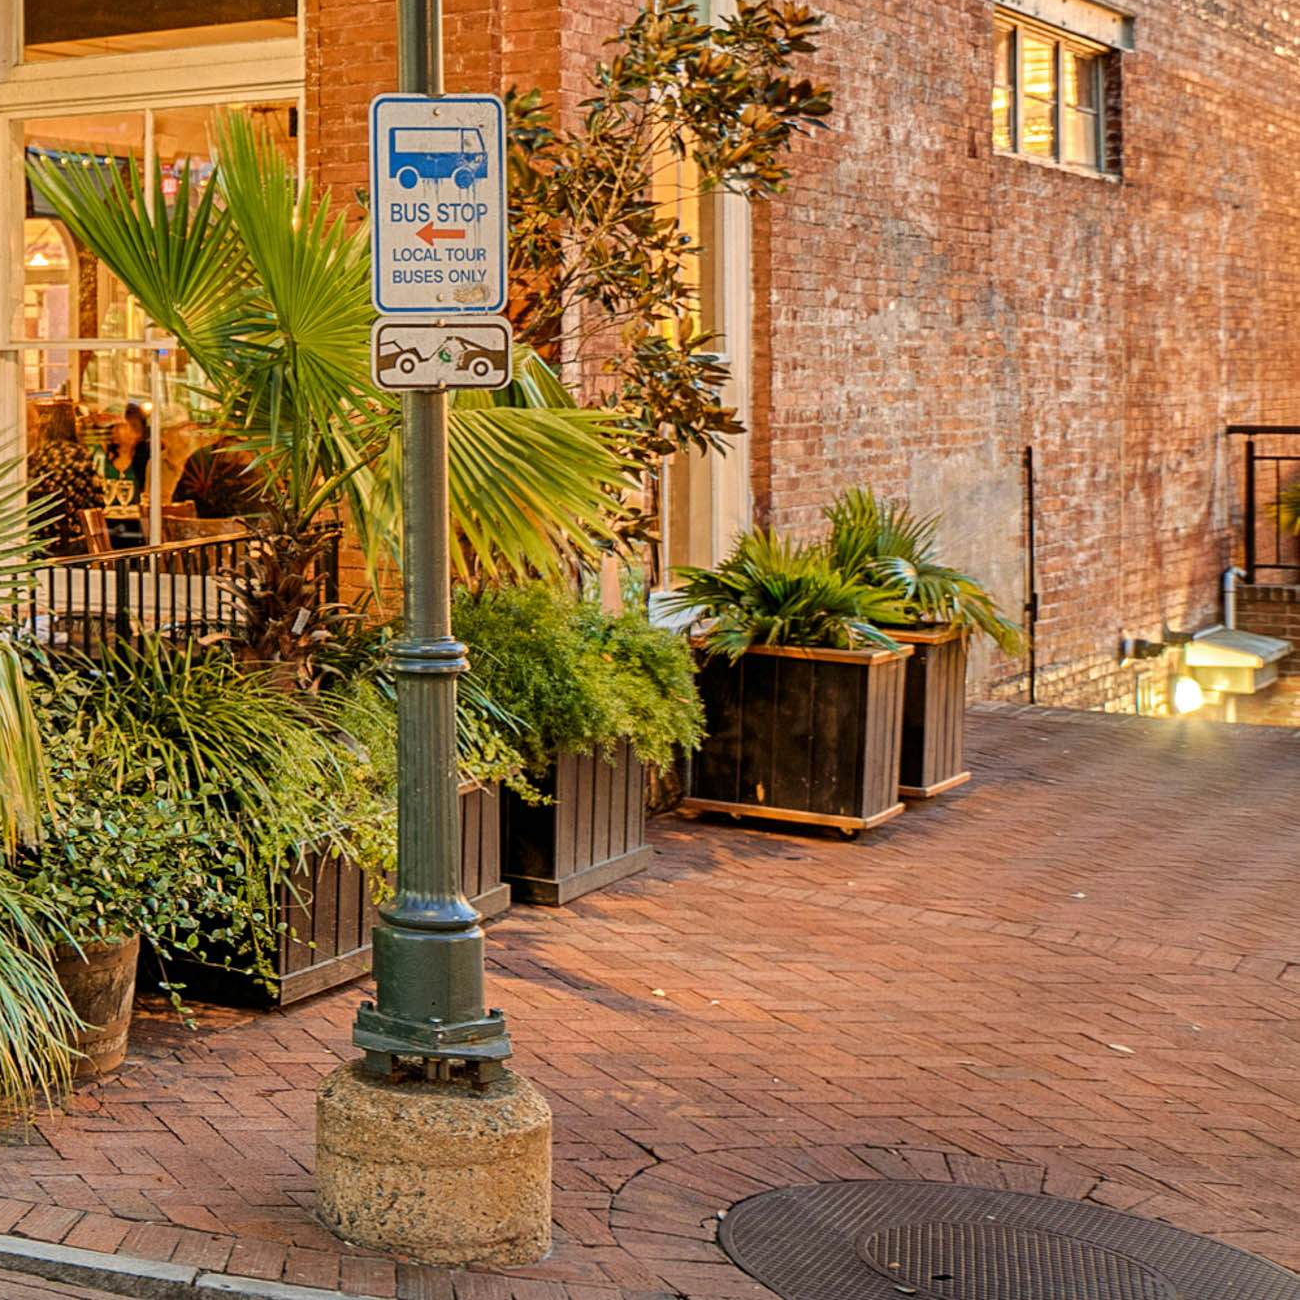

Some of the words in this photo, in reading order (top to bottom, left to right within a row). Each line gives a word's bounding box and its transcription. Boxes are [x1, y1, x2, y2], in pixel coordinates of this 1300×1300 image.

[390, 202, 431, 223] BUS
[436, 202, 488, 223] STOP
[392, 247, 442, 262] LOCAL
[446, 247, 487, 262] TOUR
[392, 269, 444, 284] BUSES
[447, 269, 487, 284] ONLY
